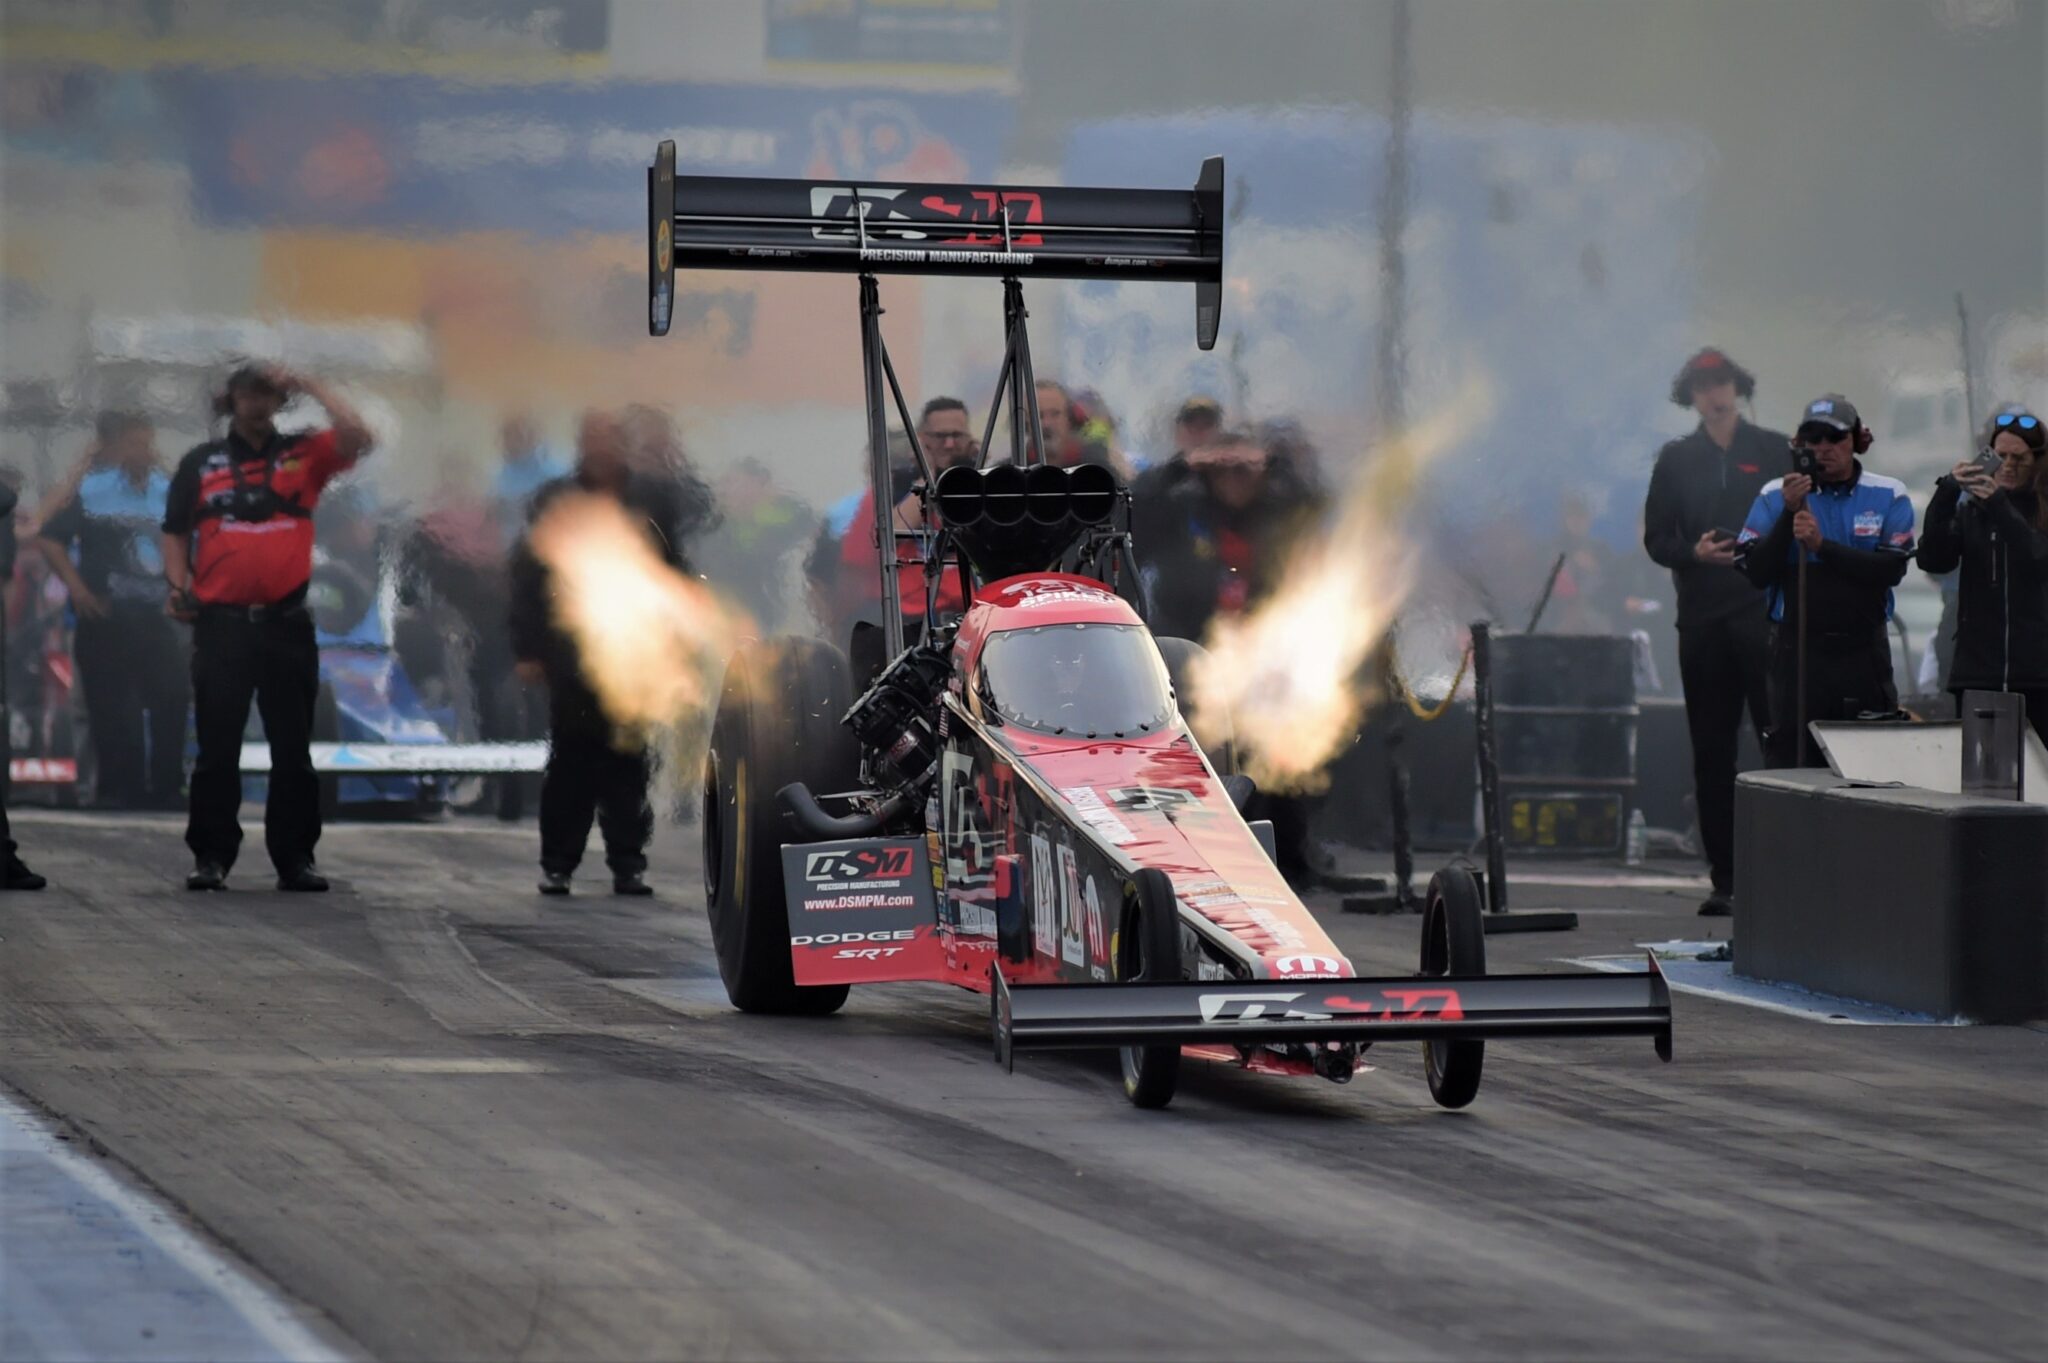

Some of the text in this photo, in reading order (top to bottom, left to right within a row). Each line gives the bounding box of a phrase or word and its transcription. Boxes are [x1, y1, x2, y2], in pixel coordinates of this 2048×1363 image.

[860, 249, 1034, 265] PRECISION MANUFACTURING
[806, 848, 913, 881] DSM
[804, 894, 913, 910] www.DSMPM.com
[791, 930, 915, 946] DODGE
[832, 947, 904, 960] SRT
